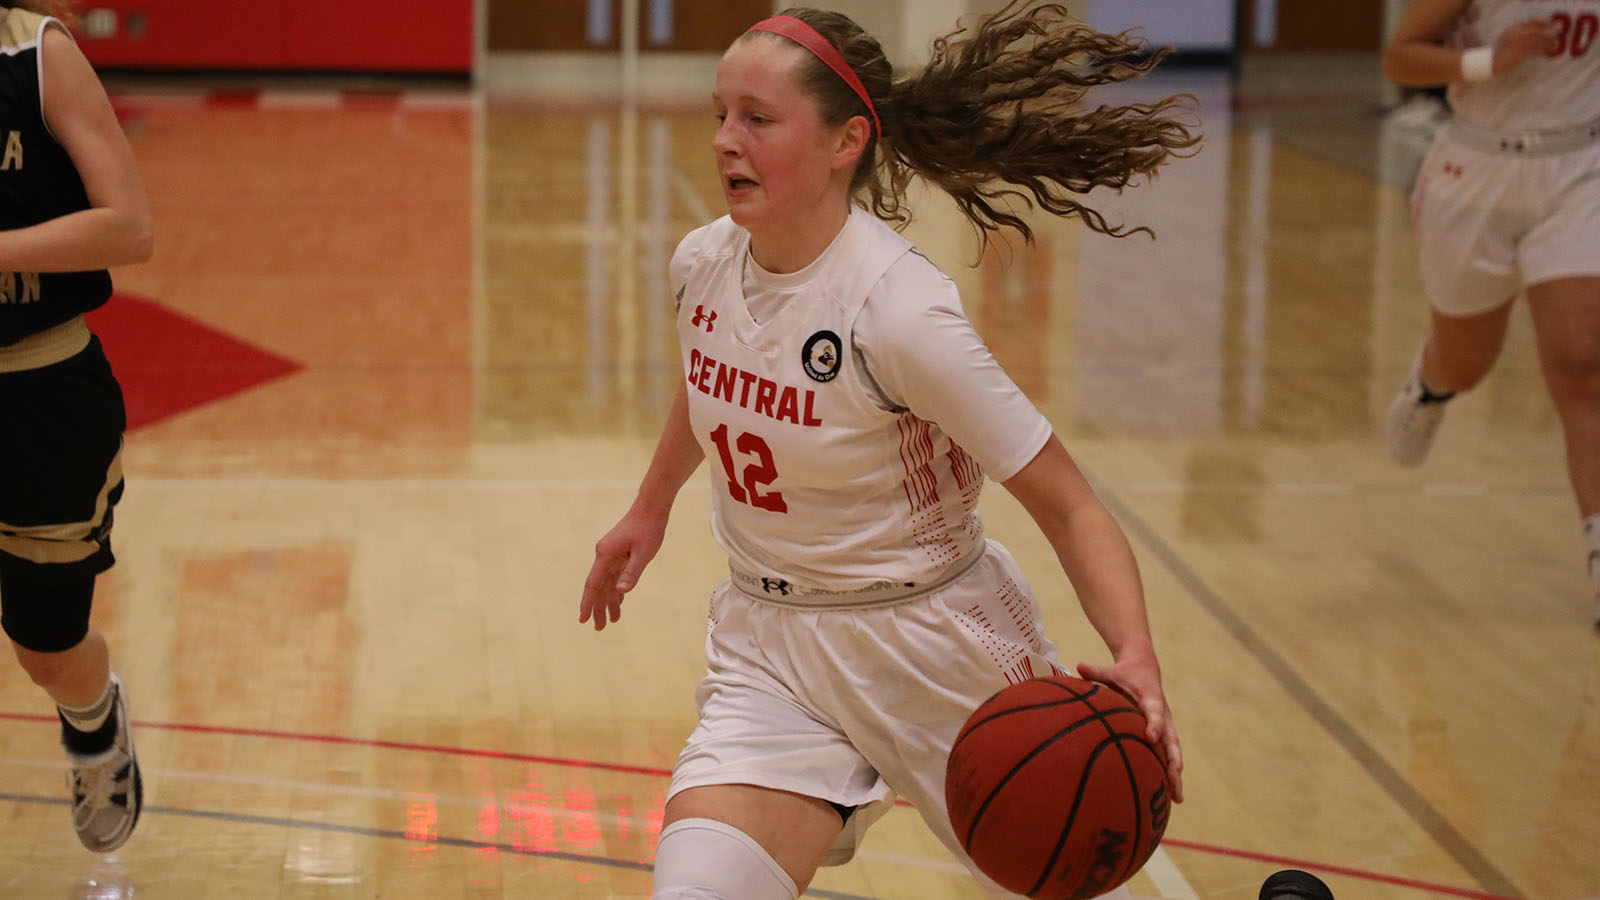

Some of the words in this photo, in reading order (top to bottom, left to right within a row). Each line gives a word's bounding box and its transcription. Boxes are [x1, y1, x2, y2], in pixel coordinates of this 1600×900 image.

[1547, 12, 1599, 58] 30
[688, 348, 822, 427] CENTRAL
[710, 423, 788, 514] 12
